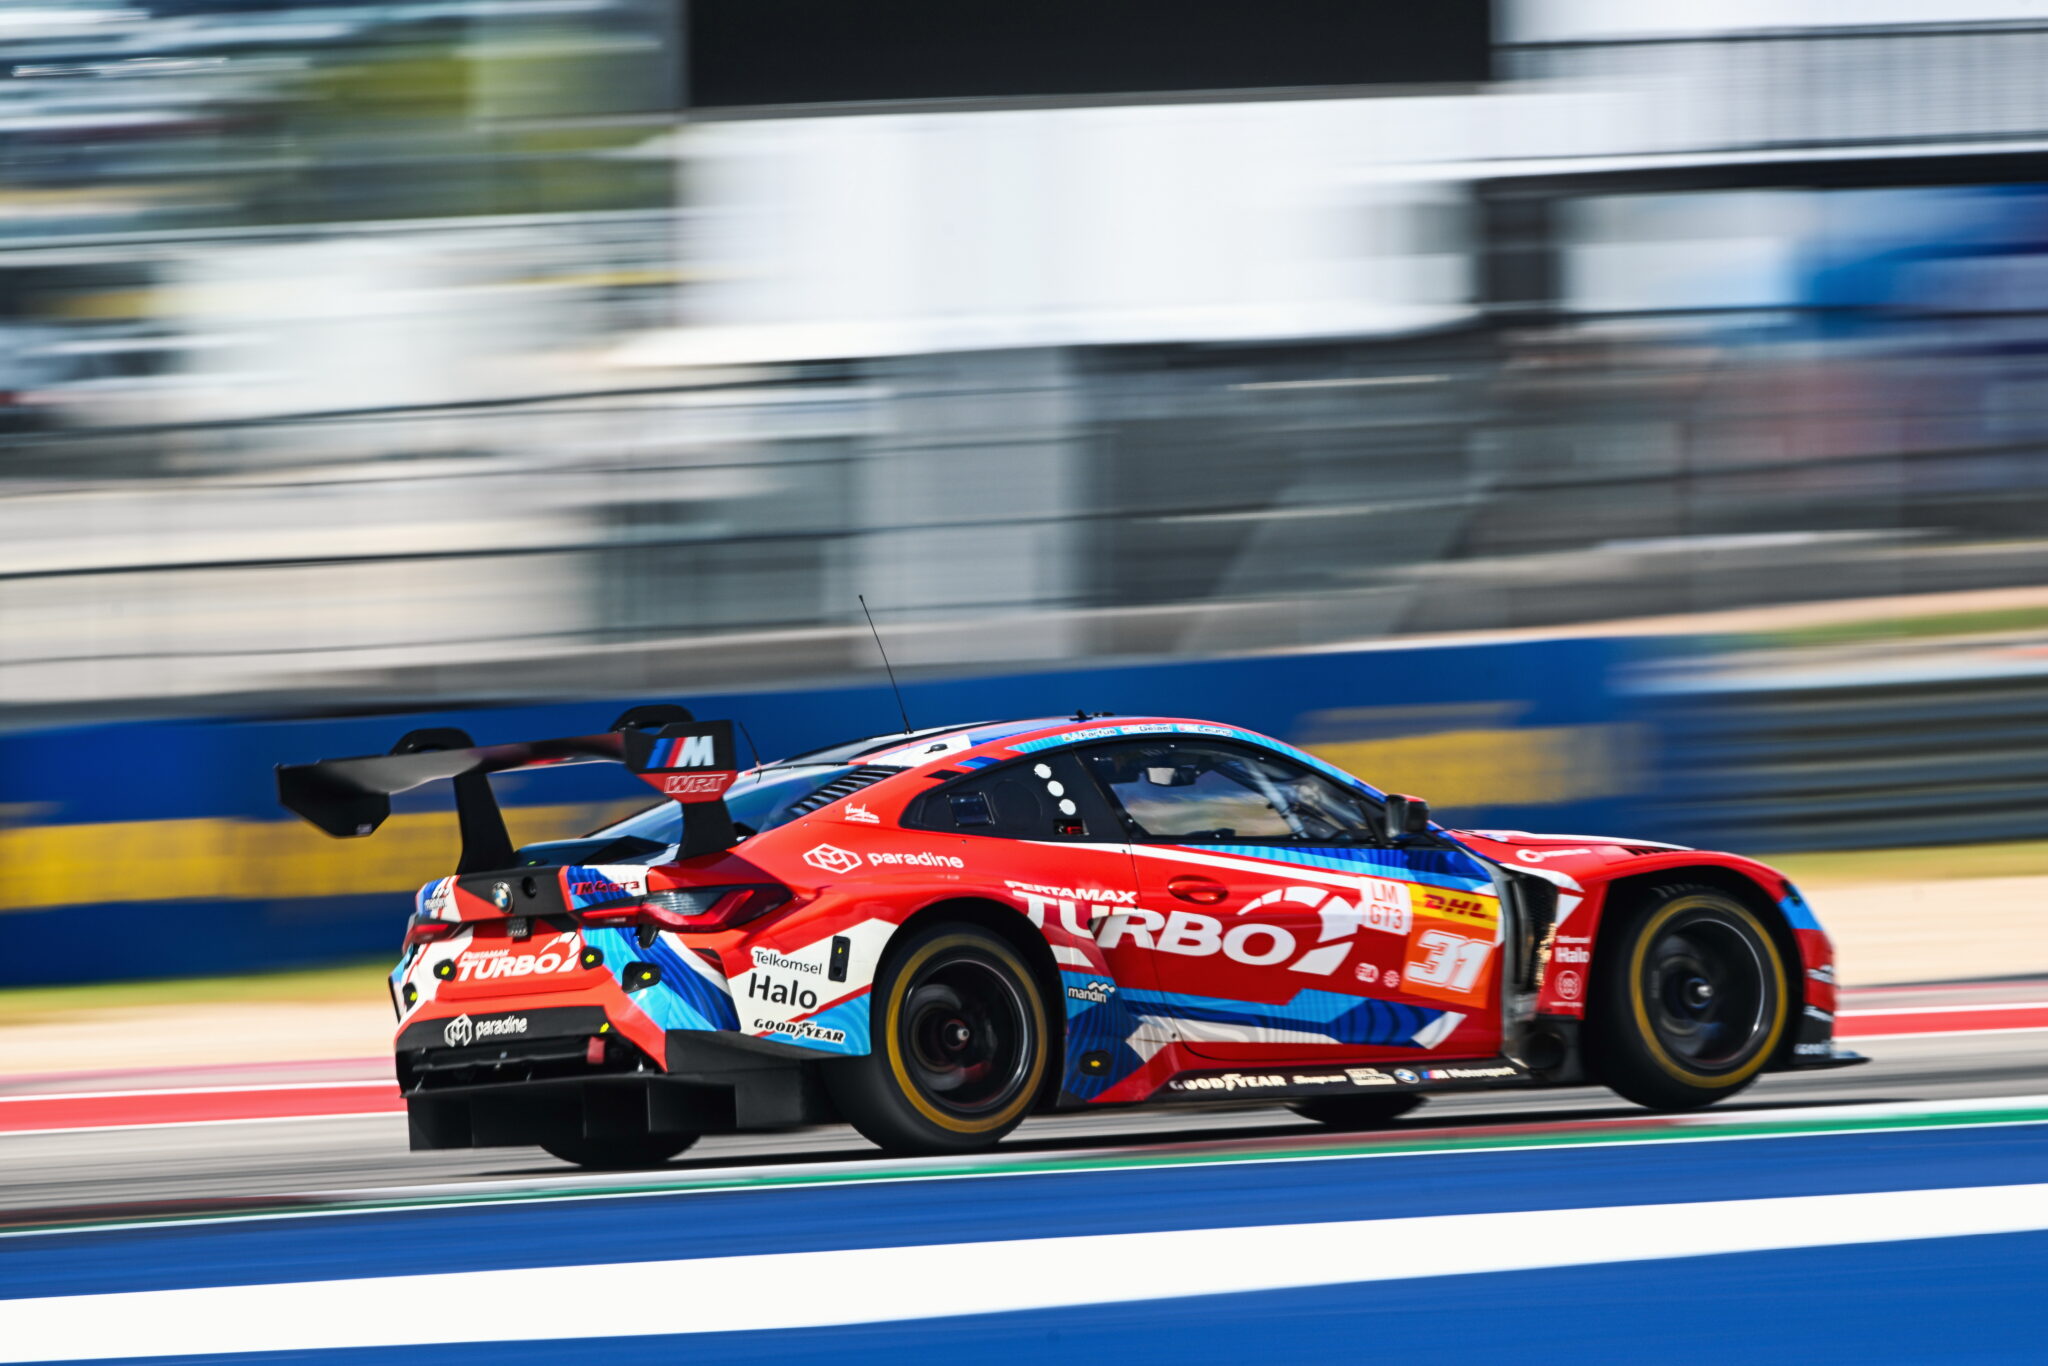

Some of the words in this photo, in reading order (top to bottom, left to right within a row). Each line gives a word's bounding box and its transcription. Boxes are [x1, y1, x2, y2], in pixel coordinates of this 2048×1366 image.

[673, 735, 715, 768] M
[664, 774, 728, 793] WRT
[867, 852, 964, 869] paradine
[1004, 880, 1137, 904] PERTAMAX
[1371, 881, 1399, 904] LM
[1370, 903, 1403, 929] GT3
[1424, 893, 1488, 919] DHL
[1012, 889, 1297, 966] TURBO
[457, 953, 562, 982] TURBO
[755, 951, 823, 975] Telkomsel
[1403, 929, 1496, 994] 31
[1555, 947, 1590, 963] Halo
[749, 972, 817, 1009] Halo
[475, 1014, 528, 1041] paradine
[753, 1018, 844, 1042] GOODYEAR
[1169, 1073, 1287, 1091] GOODYEAR
